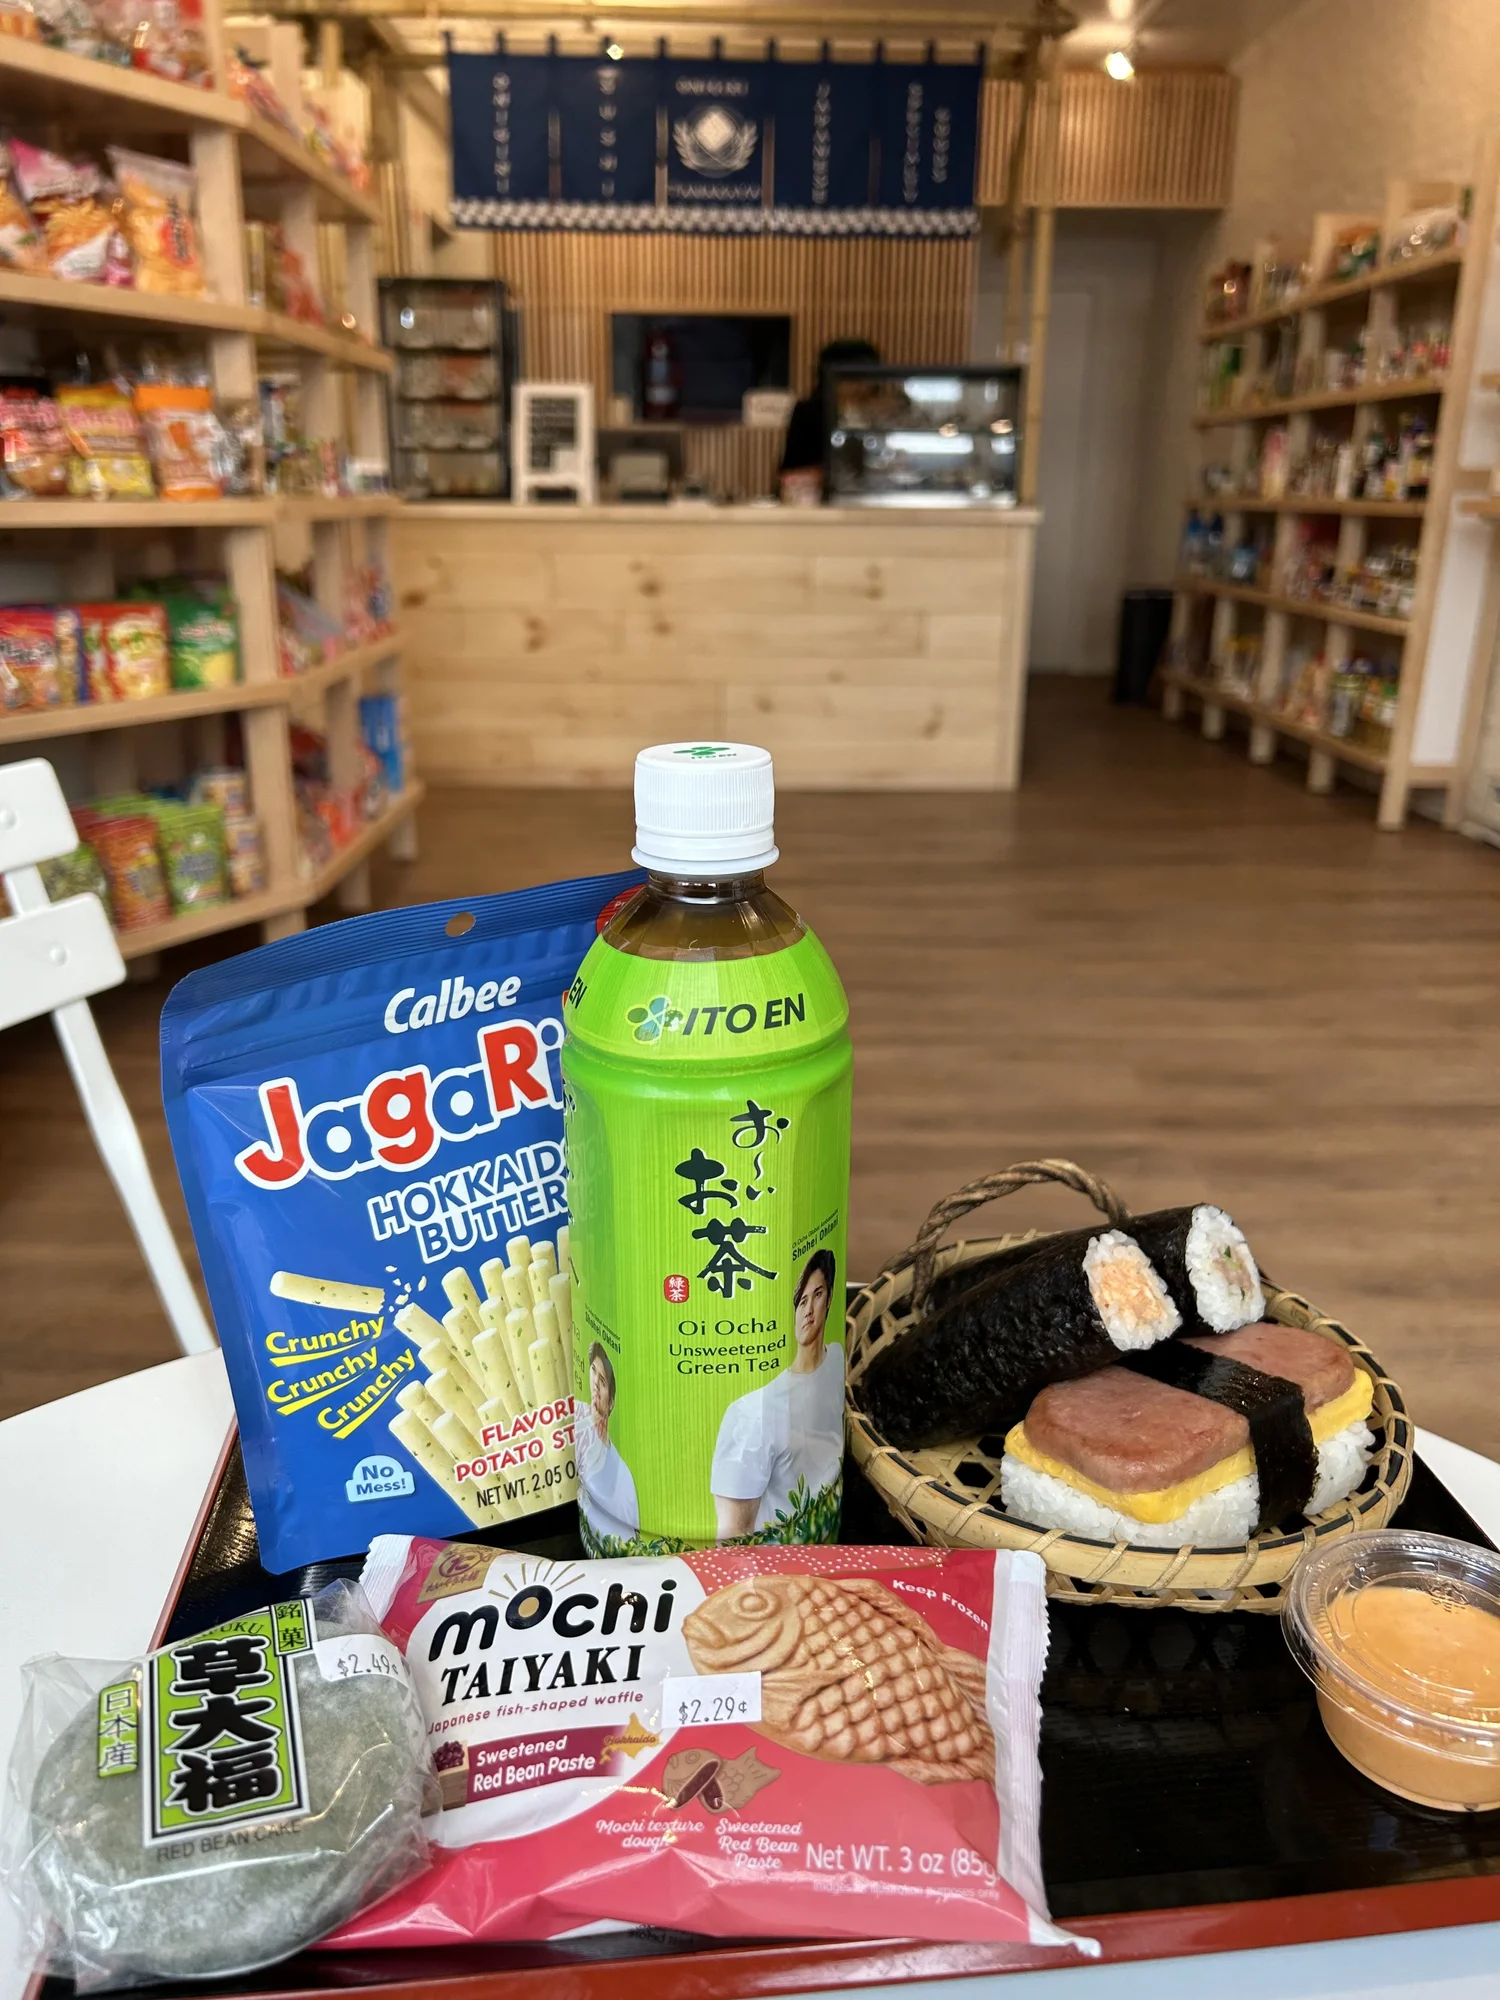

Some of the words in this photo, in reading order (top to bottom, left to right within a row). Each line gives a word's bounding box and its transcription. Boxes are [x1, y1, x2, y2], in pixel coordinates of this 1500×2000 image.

[383, 975, 522, 1034] Calbee
[682, 1004, 757, 1036] ITO
[764, 993, 806, 1030] EN
[367, 1140, 569, 1241] HOKKAID
[415, 1180, 569, 1265] BUTTER
[675, 1148, 779, 1299] お茶
[792, 1234, 818, 1262] Shohei
[265, 1316, 385, 1354] Crunchy
[669, 1334, 787, 1357] Unsweetened
[678, 1321, 706, 1336] Oi
[714, 1318, 777, 1336] Ocha
[266, 1346, 379, 1404] Crunchy
[677, 1359, 740, 1375] Green
[745, 1356, 780, 1372] Tea
[316, 1347, 416, 1430] Crunchy
[361, 1465, 395, 1481] No
[455, 1438, 544, 1482] POTATO
[356, 1478, 406, 1496] Mess!
[476, 1486, 502, 1508] NET
[503, 1478, 530, 1500] WT.
[531, 1465, 562, 1492] 2.05
[277, 1602, 304, 1648] 銘菓
[428, 1578, 677, 1662] mochi
[892, 1579, 937, 1599] Keep
[942, 1592, 988, 1631] Frozen
[441, 1644, 645, 1707] TAIYAKI
[98, 1688, 138, 1770] 日本産
[164, 1633, 283, 1817] 草大福
[428, 1711, 491, 1736] Japanese
[496, 1697, 588, 1719] fish-shaped
[594, 1690, 644, 1707] waffle
[678, 1696, 747, 1725] $2.29¢
[475, 1735, 568, 1767] Sweetened
[473, 1771, 503, 1793] Red
[505, 1761, 545, 1787] Bean
[548, 1753, 596, 1778] Paste
[157, 1842, 194, 1862] RED
[201, 1831, 249, 1853] BEAN
[253, 1820, 302, 1842] CAKE
[596, 1818, 646, 1834] Mochi
[647, 1818, 704, 1832] texture
[715, 1817, 803, 1836] Sweetened
[717, 1835, 751, 1852] Red
[756, 1835, 800, 1853] Bean
[733, 1851, 782, 1869] Paste
[806, 1843, 844, 1870] Net
[851, 1844, 892, 1872] WT.
[900, 1846, 913, 1873] 3
[919, 1853, 944, 1873] oz
